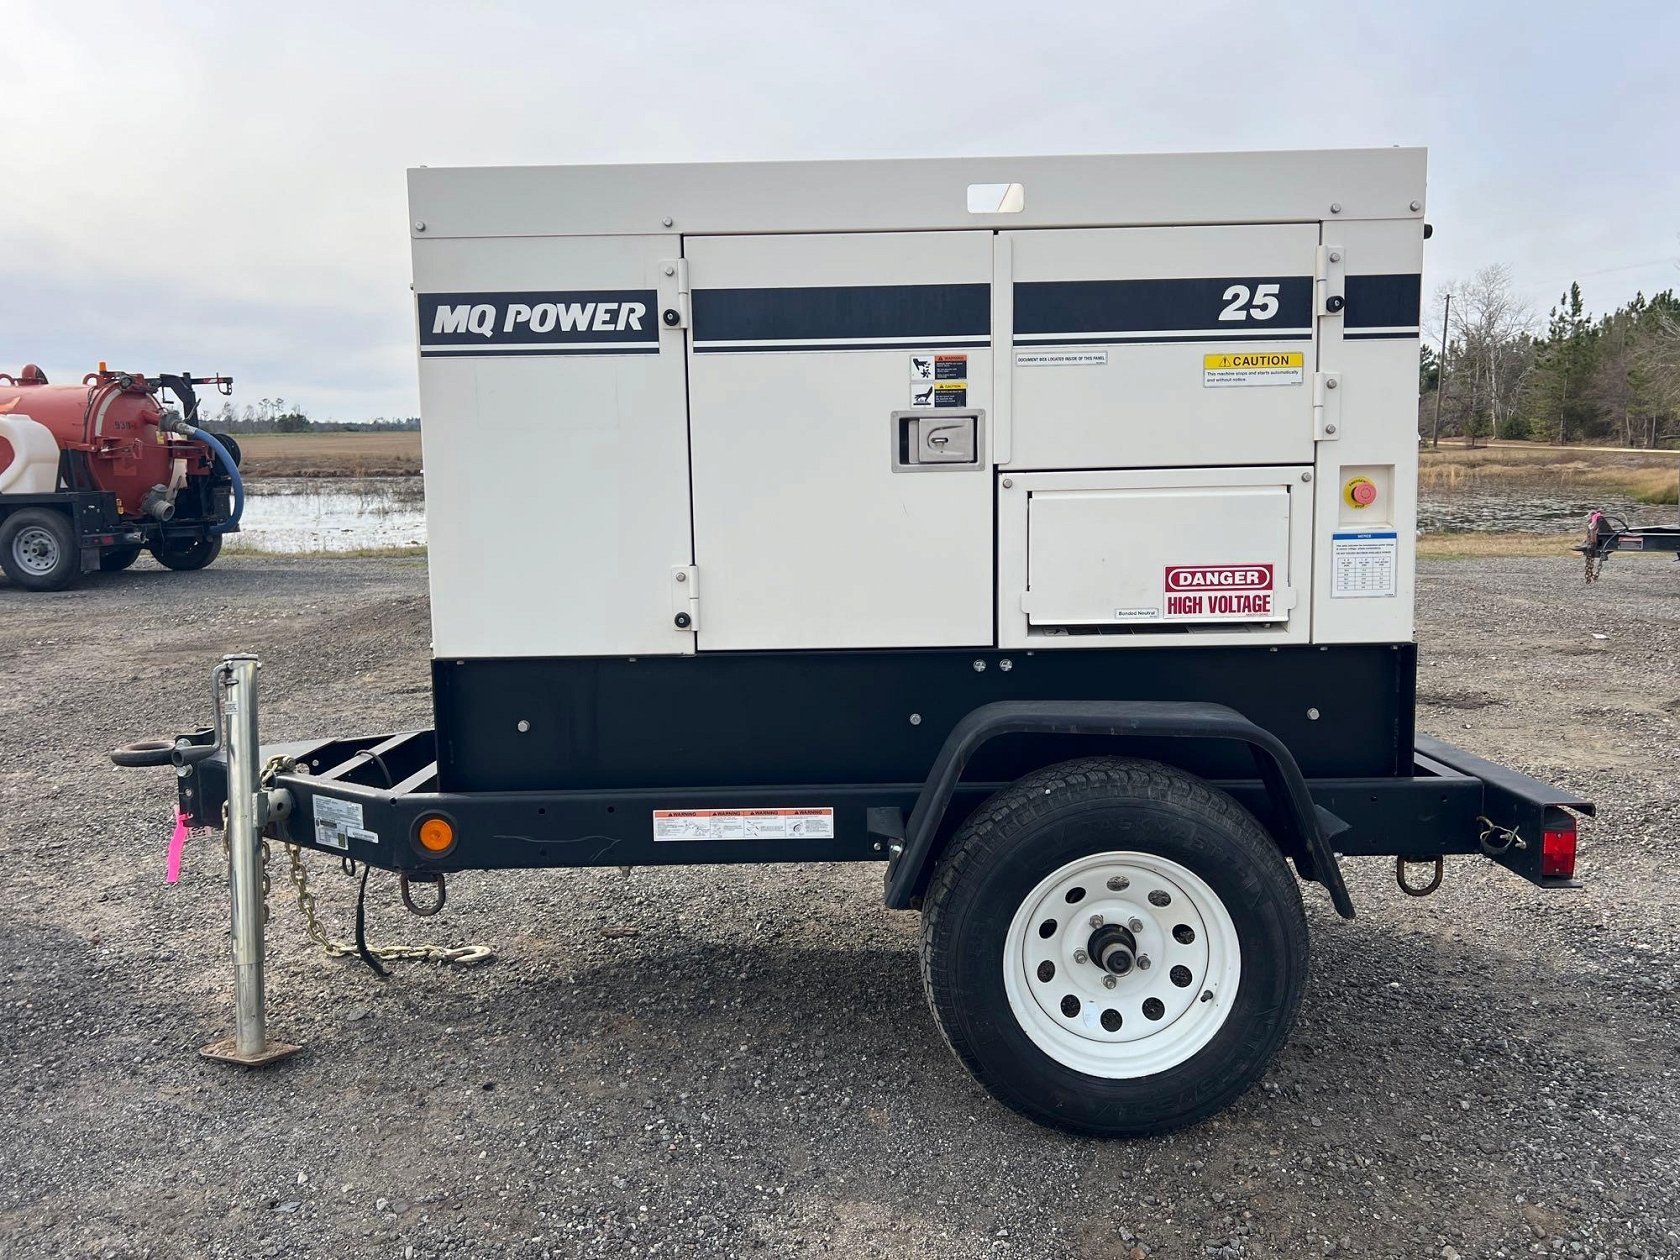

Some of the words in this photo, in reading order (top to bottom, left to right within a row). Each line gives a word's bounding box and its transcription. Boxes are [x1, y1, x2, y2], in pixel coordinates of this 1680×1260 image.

[1218, 284, 1280, 321] 25
[432, 303, 497, 338] MQ
[503, 302, 647, 333] POWER
[1233, 355, 1289, 366] CAUTION
[1179, 571, 1259, 586] DANGER
[1168, 595, 1203, 614] HIGH
[1208, 594, 1271, 614] VOLTAGE
